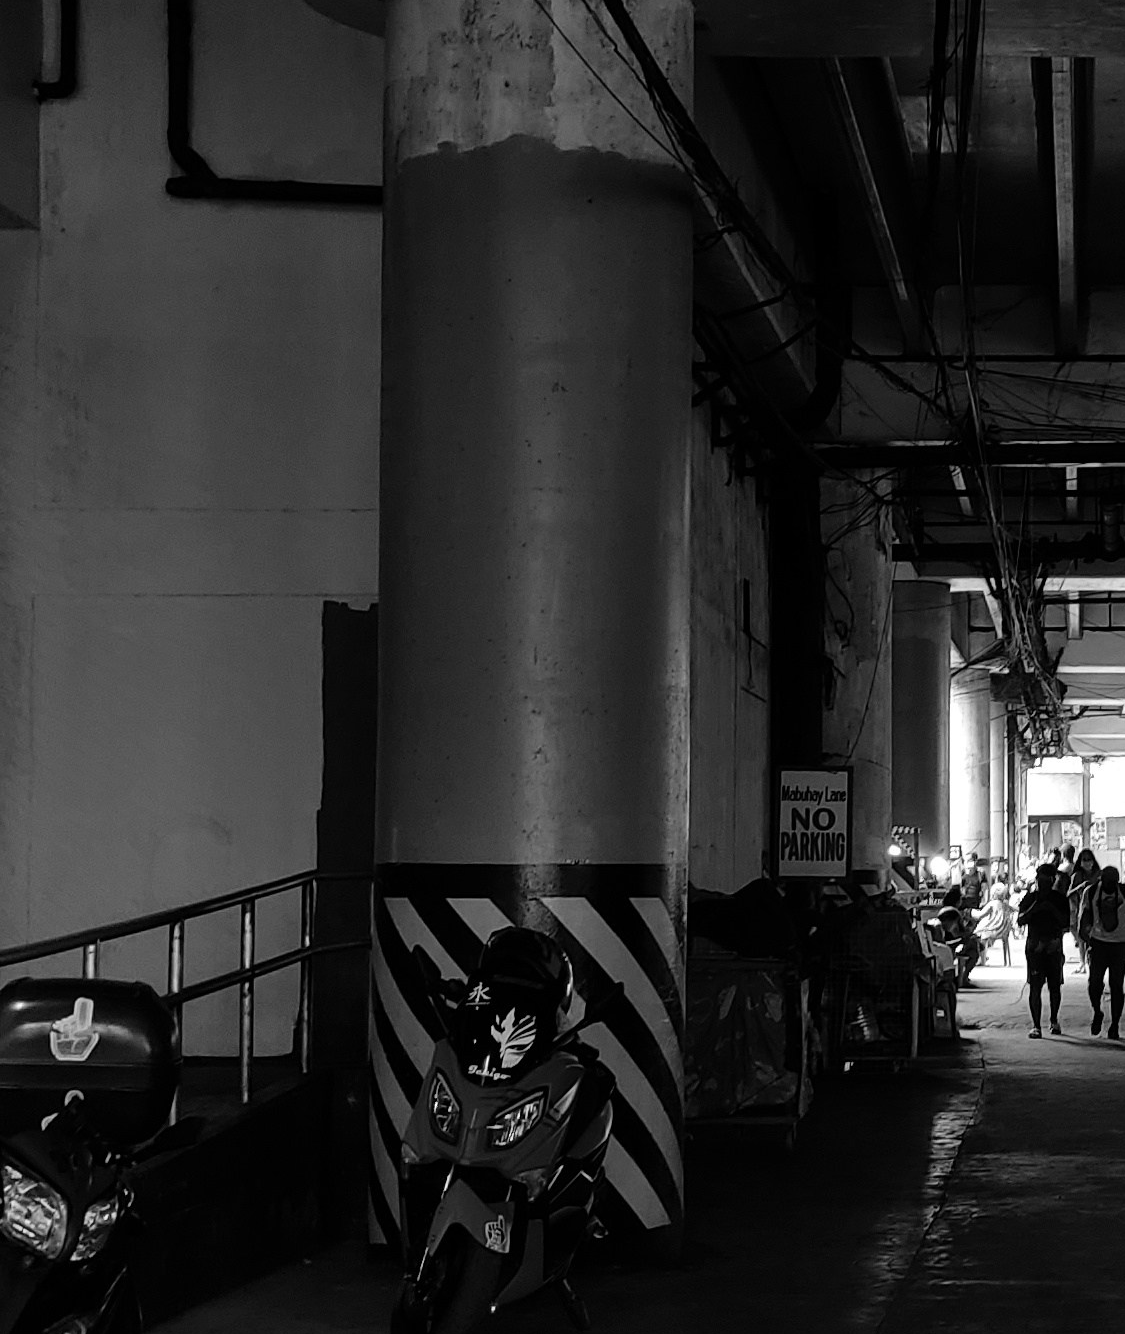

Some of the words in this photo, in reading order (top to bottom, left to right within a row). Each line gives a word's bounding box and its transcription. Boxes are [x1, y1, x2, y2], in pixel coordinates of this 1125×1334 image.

[781, 785, 823, 806] Mabuhay
[825, 786, 846, 802] Lane
[791, 807, 836, 831] NO
[780, 832, 845, 861] PARKING
